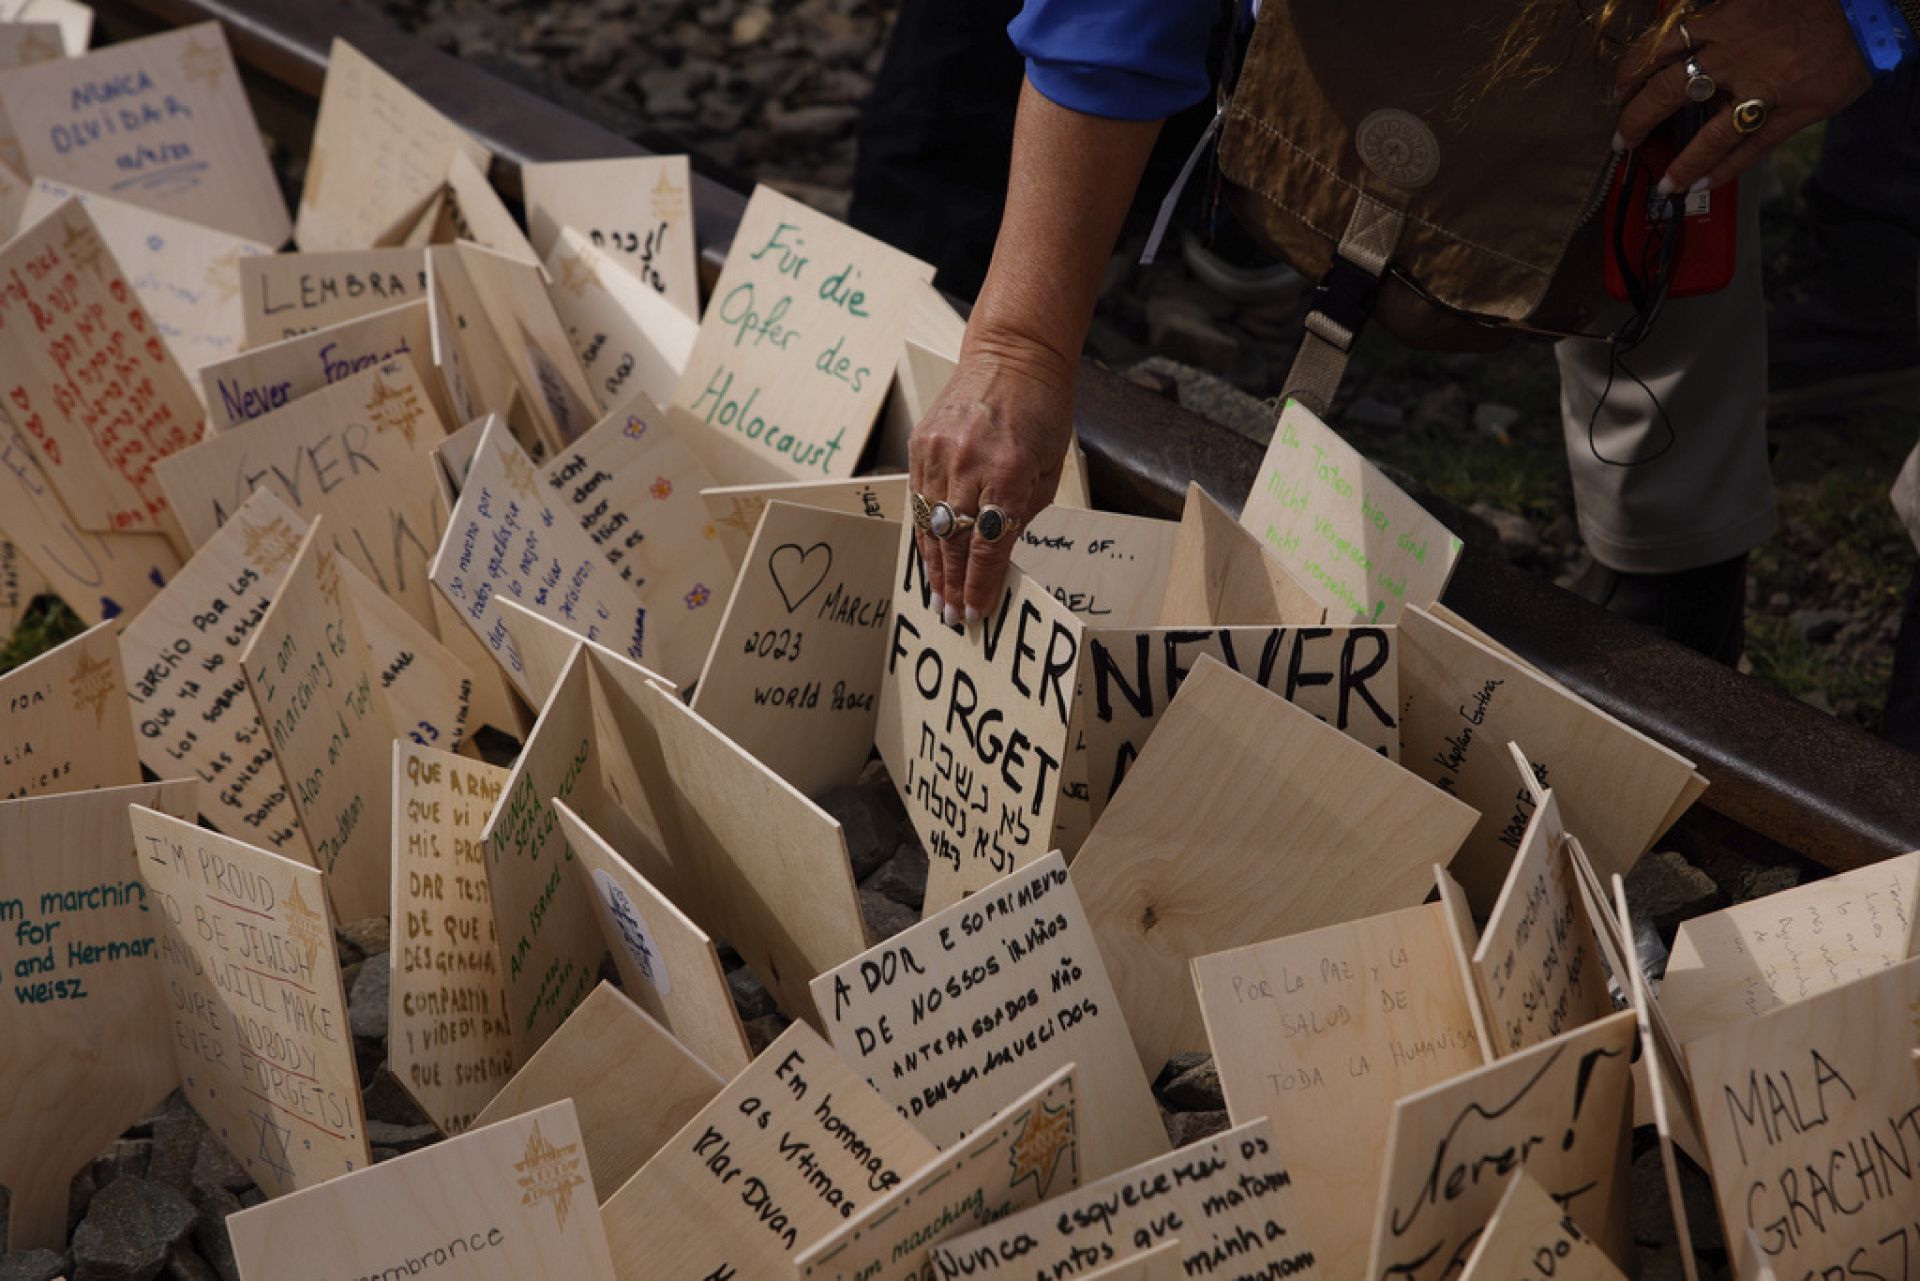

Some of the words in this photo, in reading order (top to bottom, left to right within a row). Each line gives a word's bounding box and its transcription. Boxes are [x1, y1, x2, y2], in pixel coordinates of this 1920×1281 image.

[71, 69, 154, 112] NUNCA
[752, 222, 808, 279] Für
[818, 264, 870, 318] die
[719, 283, 802, 347] Opfer
[815, 337, 871, 393] des
[217, 378, 291, 422] Never
[691, 365, 848, 475] Holocaust
[817, 582, 890, 628] MARCH
[903, 522, 1077, 728] NVER
[277, 633, 298, 674] am
[743, 628, 804, 662] 2023
[889, 613, 1060, 817] FORGET
[407, 755, 442, 788] QUE
[407, 798, 440, 824] QUE
[145, 835, 190, 879] I'M
[198, 846, 275, 912] PROUD
[410, 871, 444, 901] DAR
[16, 920, 61, 947] for
[194, 904, 230, 953] BE
[235, 921, 314, 985] JEWISH
[443, 914, 480, 944] QUE
[15, 946, 56, 978] and
[833, 974, 851, 1022] A
[860, 947, 926, 994] DOR
[938, 926, 956, 951] E
[170, 980, 222, 1032] SURE
[280, 988, 337, 1044] MAKE
[855, 1014, 894, 1057] DE
[911, 955, 1001, 1026] NOSSOS
[1280, 1004, 1352, 1039] SALUD
[1380, 989, 1409, 1014] DE
[175, 1019, 231, 1070] EVER
[775, 1049, 809, 1100] Em
[1267, 1067, 1326, 1095] TODA
[1349, 1055, 1370, 1078] LA
[738, 1096, 772, 1130] as
[1723, 1048, 1857, 1168] MALA
[931, 1231, 1039, 1281] Nunca
[1182, 1217, 1286, 1279] minha
